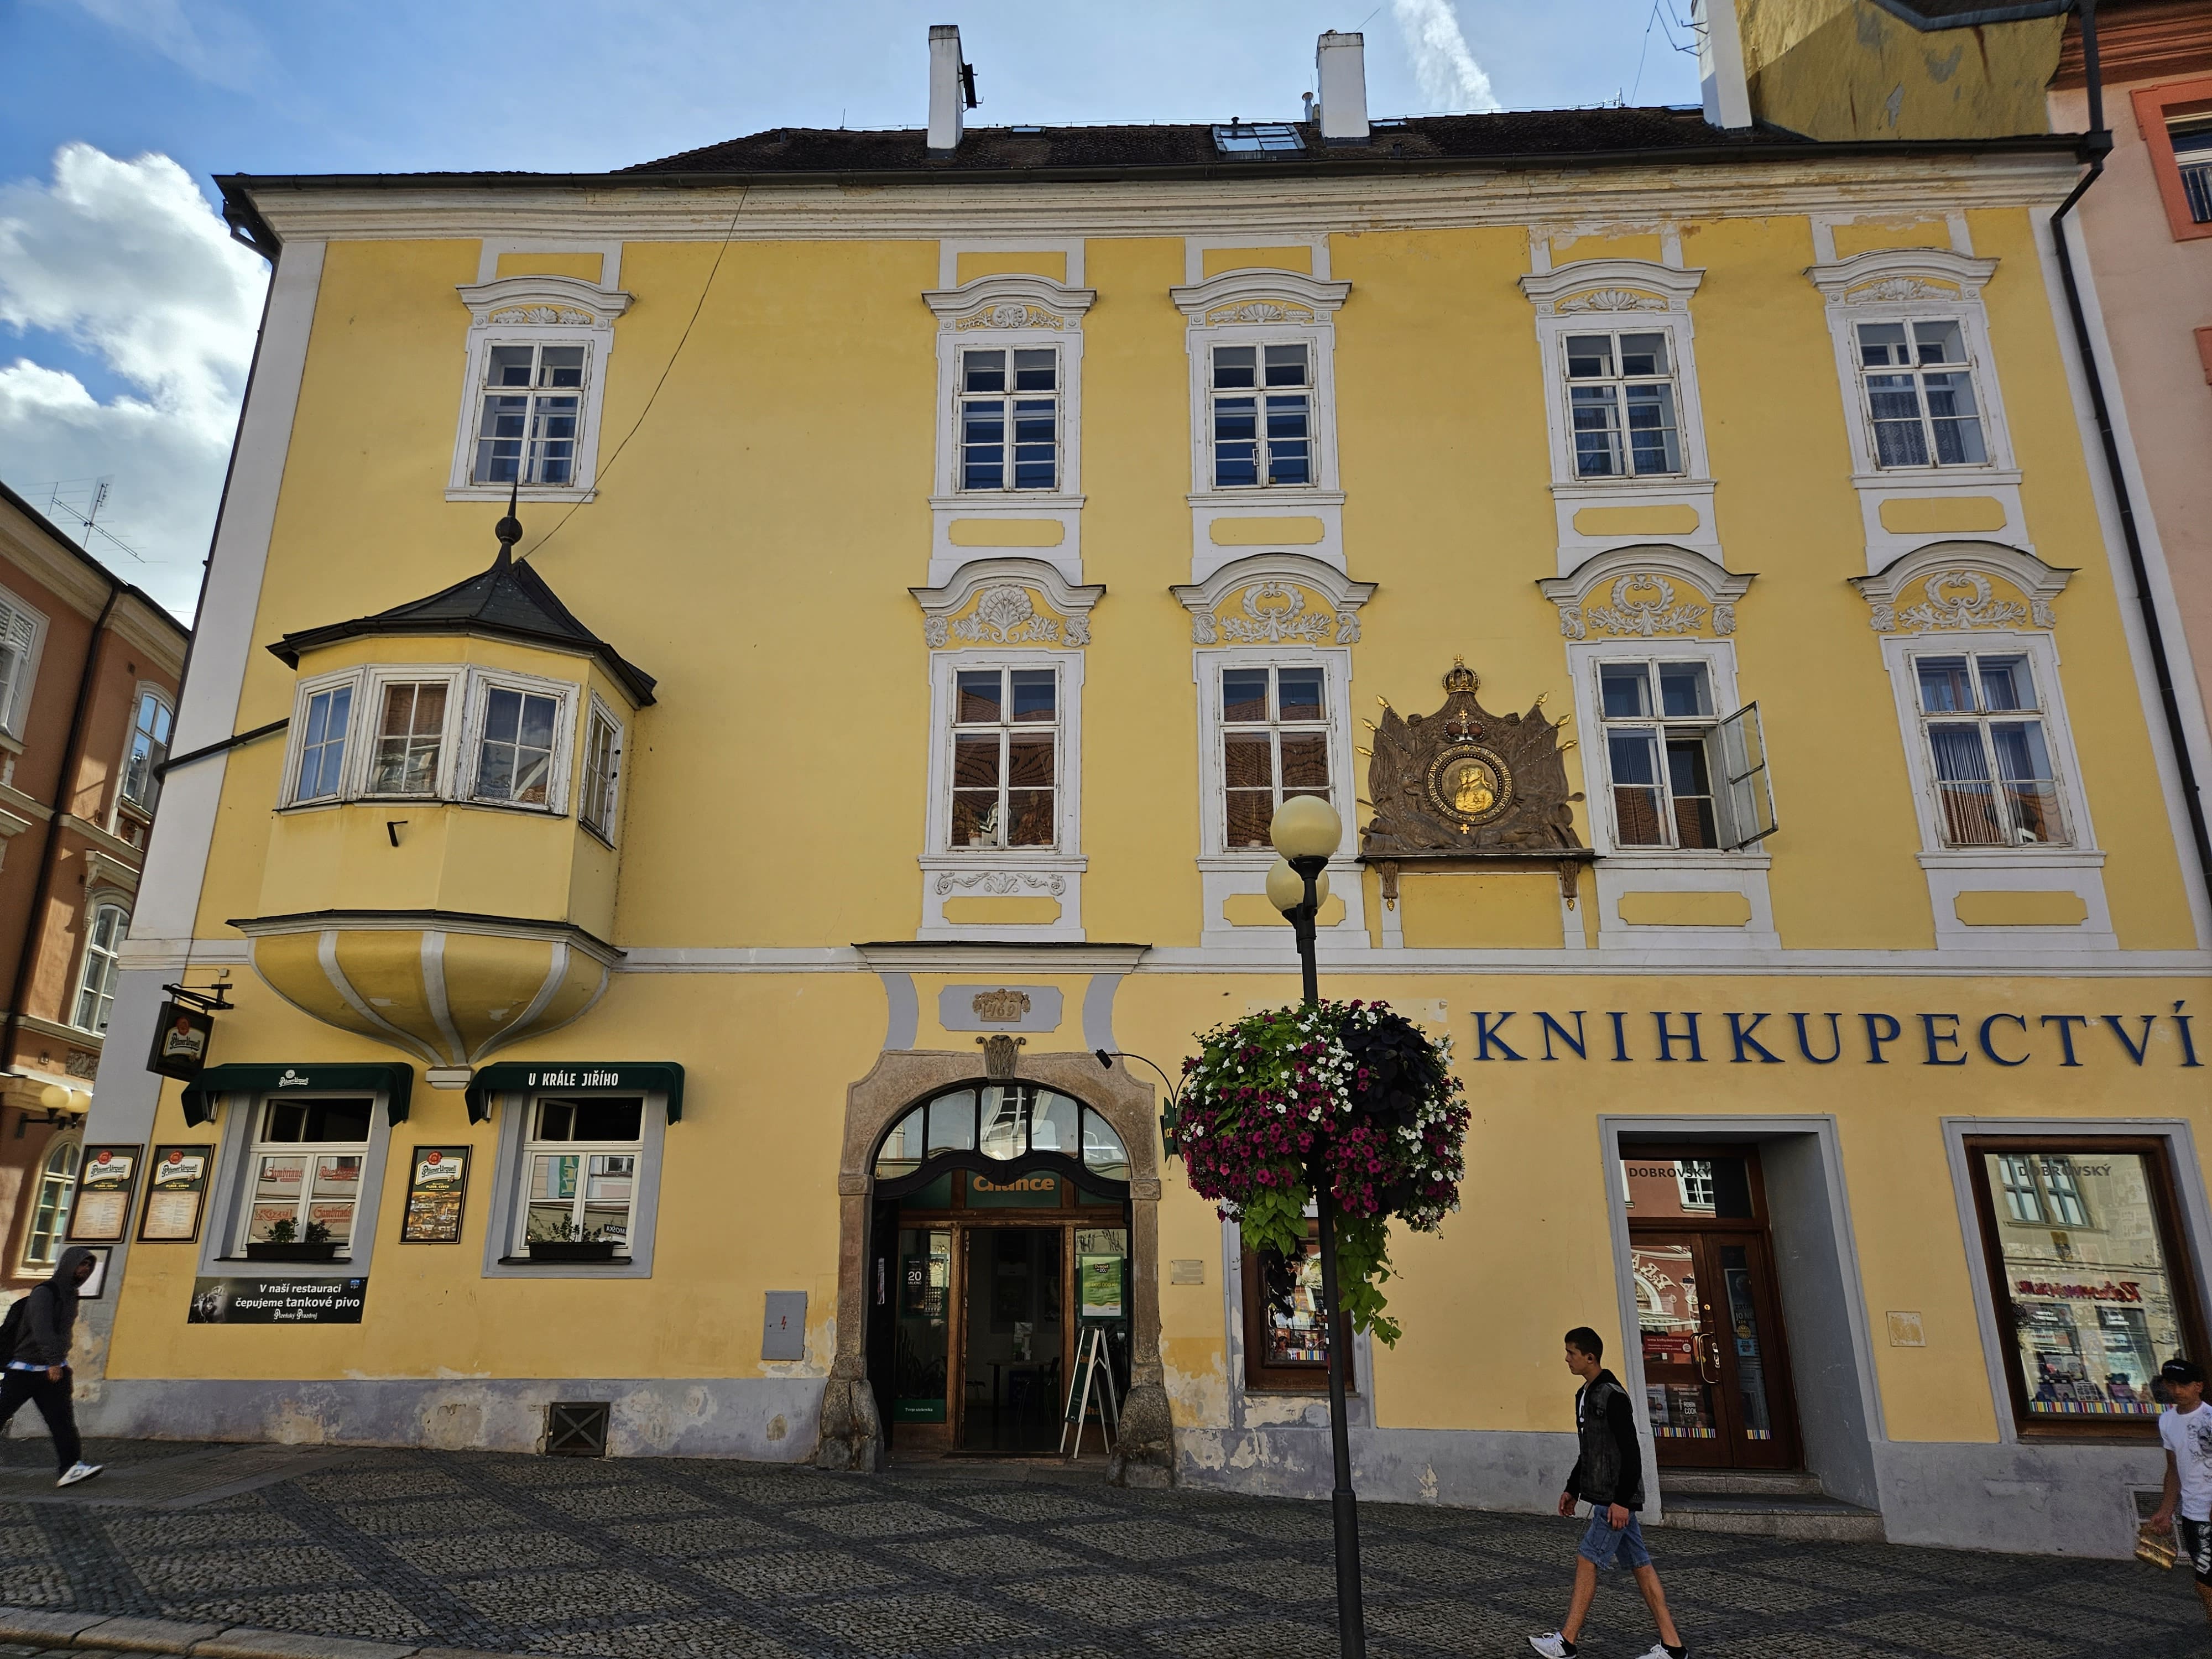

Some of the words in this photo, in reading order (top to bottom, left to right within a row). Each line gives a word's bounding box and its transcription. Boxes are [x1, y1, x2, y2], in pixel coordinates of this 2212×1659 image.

[1428, 750, 1451, 779] ZWEEN
[1428, 781, 1441, 802] DEN
[1470, 1000, 2205, 1067] KNIHKUPECTVÍ
[528, 1073, 536, 1086] U
[542, 1070, 576, 1086] KRÁLE
[581, 1070, 619, 1087] JIŘÍHO
[91, 1165, 110, 1177] Pilsner
[110, 1164, 126, 1173] Urquell
[161, 1165, 181, 1177] Pilsner
[181, 1164, 198, 1173] Urquell
[421, 1165, 440, 1178] Pilsner
[440, 1165, 457, 1174] Urquell
[2017, 1163, 2111, 1176] DOBROVSKÝ
[908, 1271, 922, 1281] 20
[259, 1284, 267, 1292] V
[269, 1283, 290, 1293] naší
[291, 1284, 341, 1293] restauraci
[236, 1298, 283, 1309] čepujeme
[286, 1296, 332, 1307] tankové
[335, 1297, 360, 1309] pivo
[296, 1308, 317, 1320] Prazdroj
